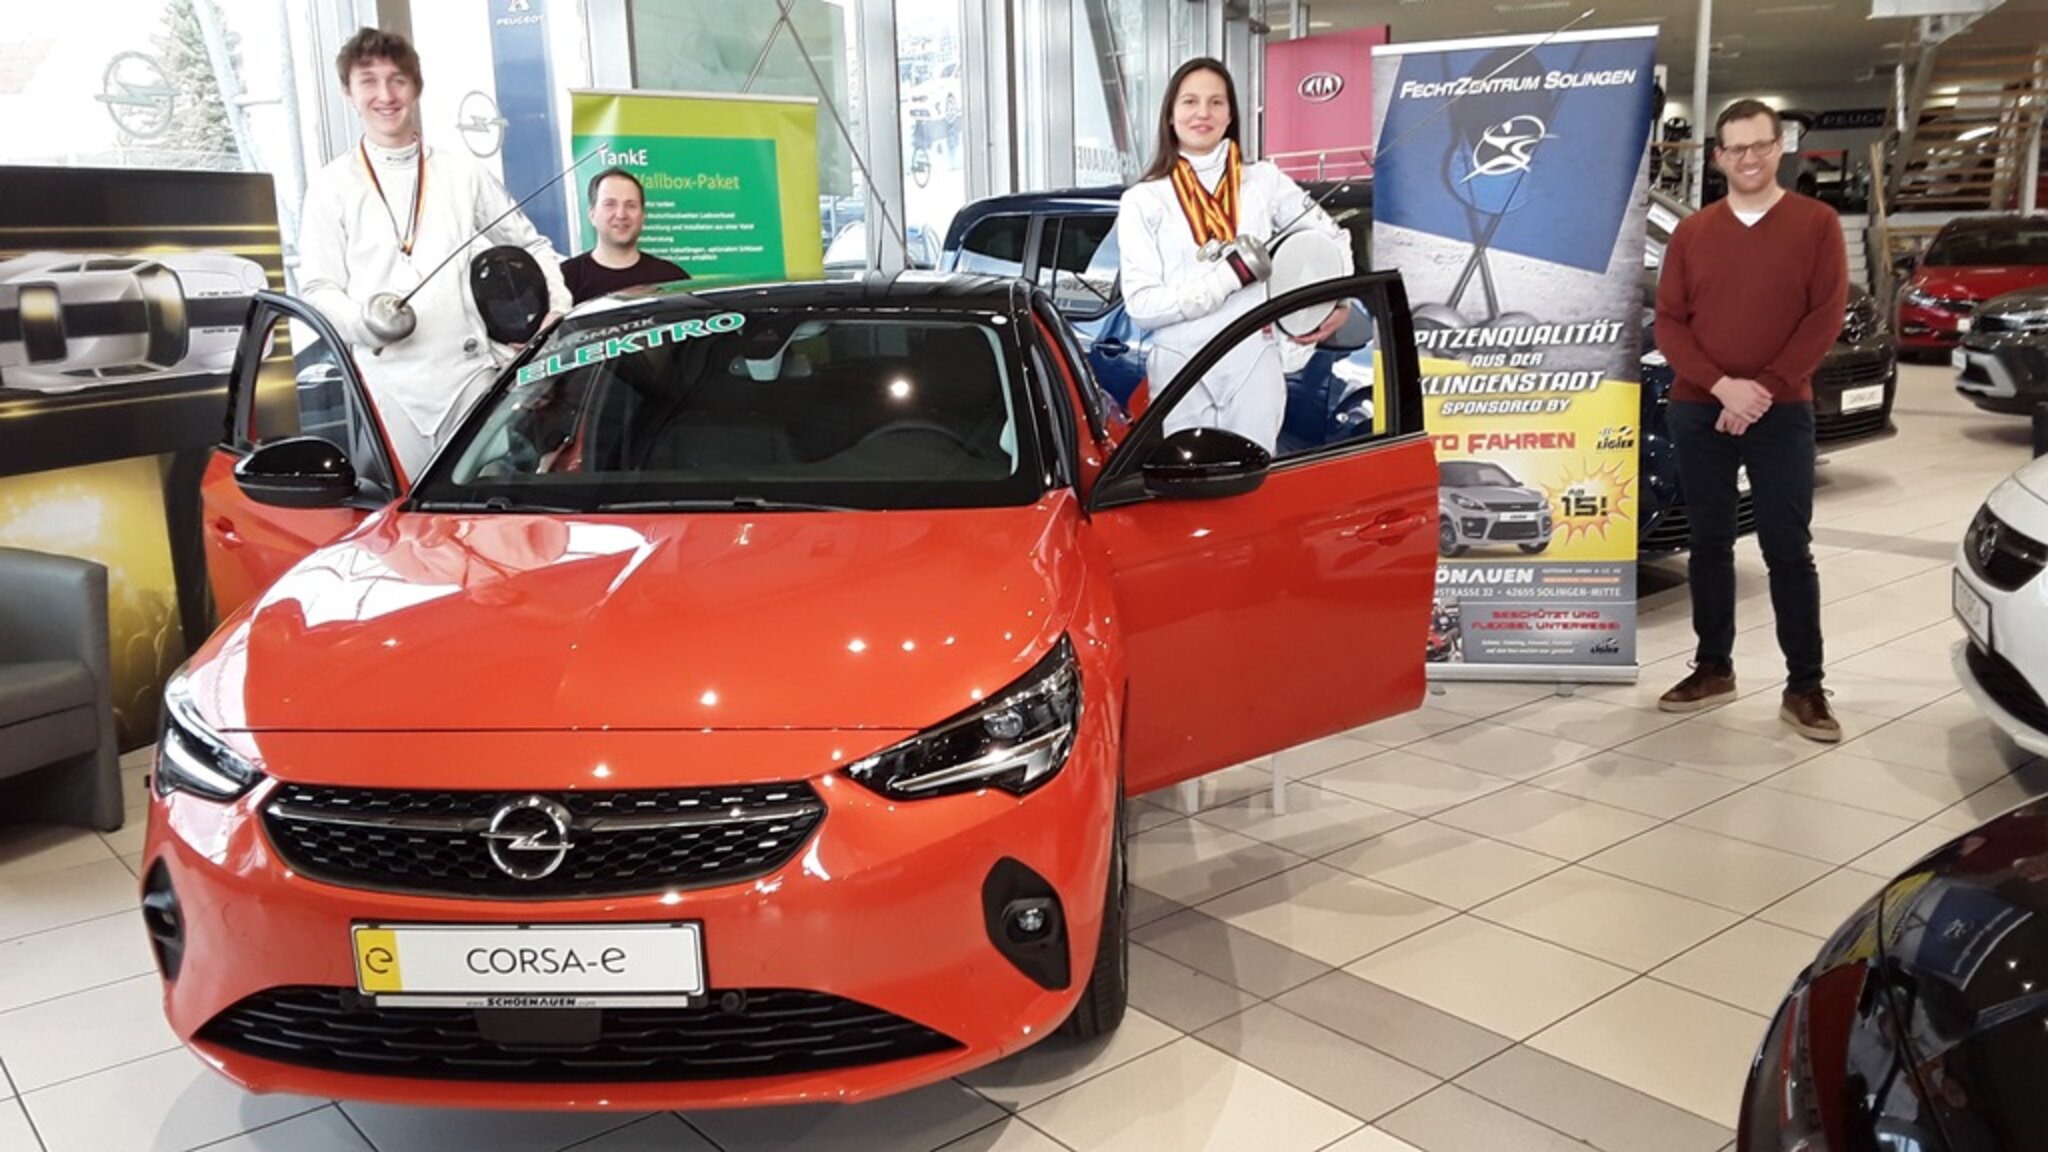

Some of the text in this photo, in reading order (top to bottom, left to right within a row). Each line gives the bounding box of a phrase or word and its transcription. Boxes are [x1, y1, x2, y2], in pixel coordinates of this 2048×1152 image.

[496, 14, 544, 26] PEUGEOT
[600, 148, 649, 166] TankE
[1414, 320, 1623, 349] PITZENQUALITÄT
[516, 311, 746, 387] ELEKTRO
[1471, 352, 1544, 368] AUS DER
[1440, 398, 1571, 416] SPONSORED BY
[1428, 432, 1576, 454] TO FAHREN
[1560, 496, 1608, 517] 15!
[1436, 564, 1535, 584] ÖNAUEN
[1434, 587, 1480, 598] STRASSE
[1572, 610, 1600, 619] UND
[466, 947, 626, 975] CORSA-e
